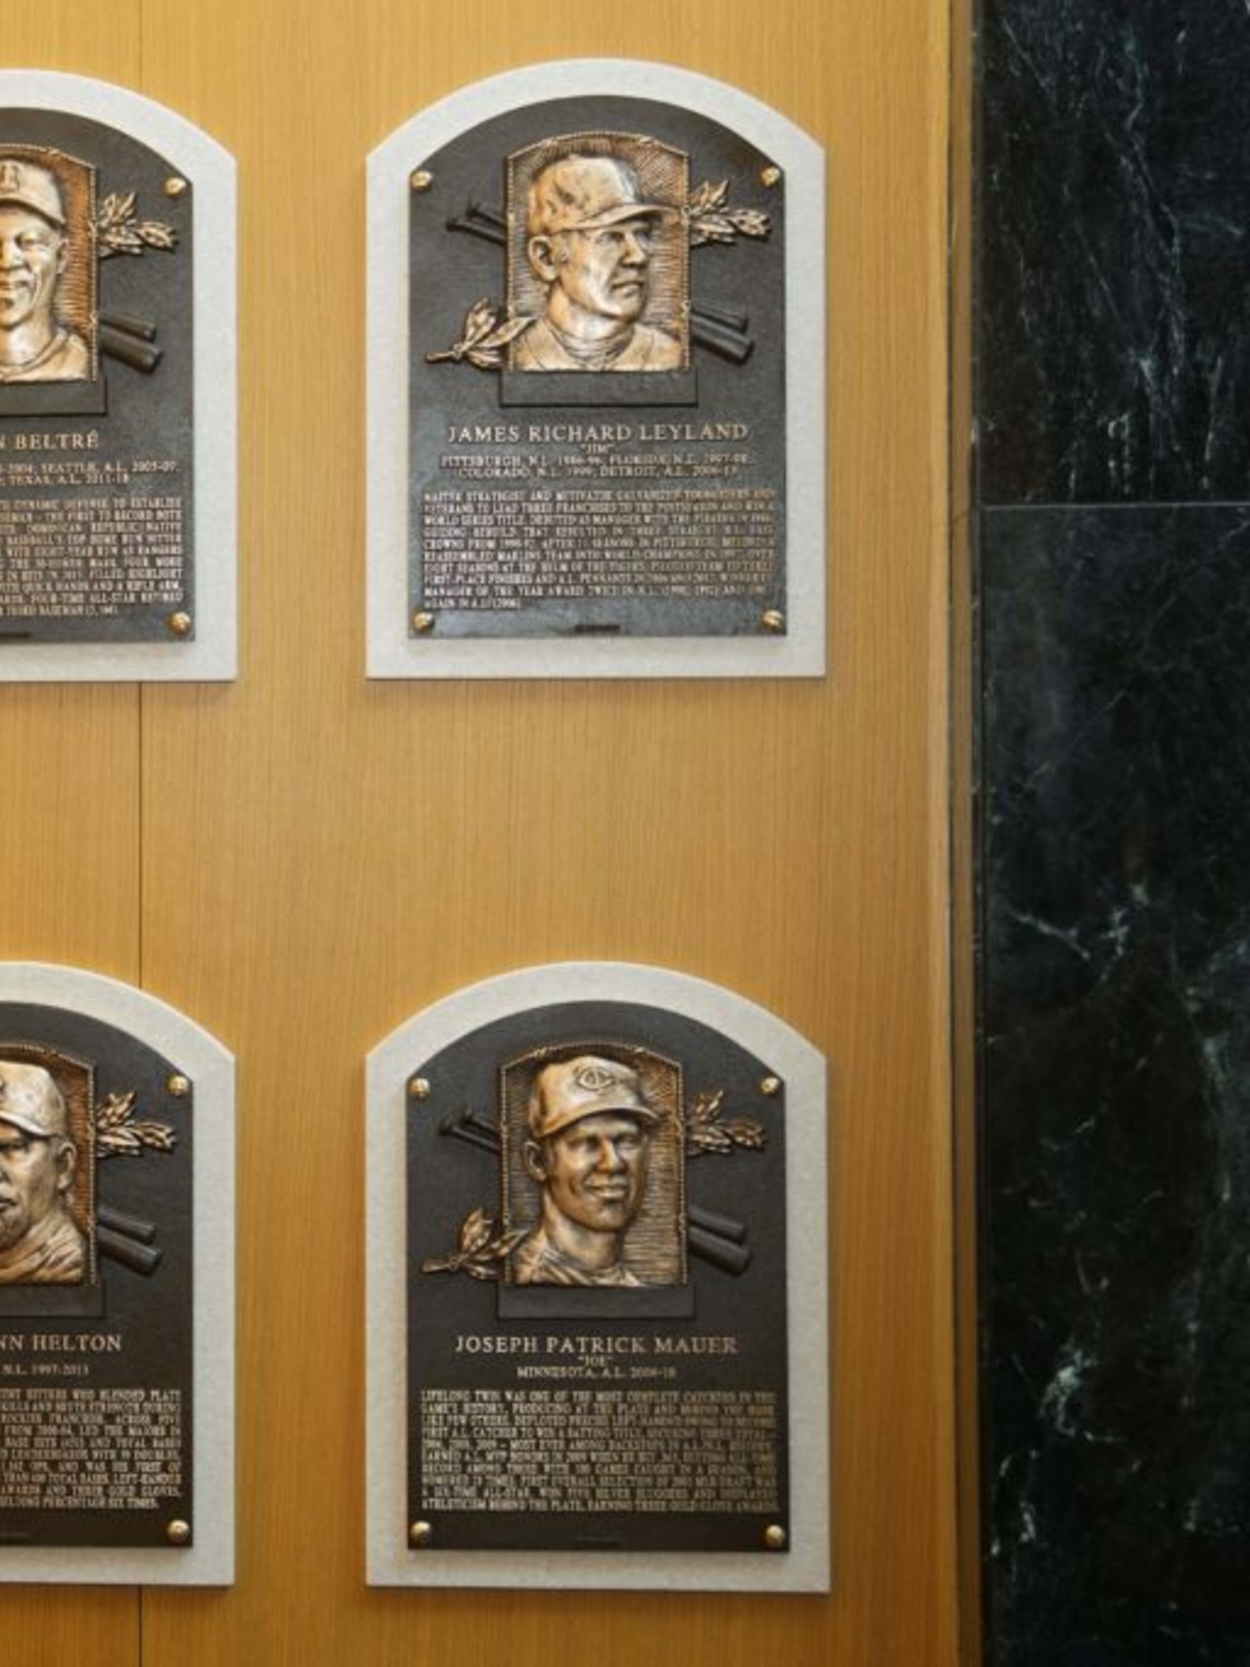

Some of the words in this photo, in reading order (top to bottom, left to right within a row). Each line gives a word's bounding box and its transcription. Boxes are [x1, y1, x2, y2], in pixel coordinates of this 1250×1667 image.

[15, 429, 99, 450] BELTRÉ
[448, 426, 519, 443] JAMES
[529, 424, 631, 442] RICHARD
[640, 423, 748, 441] LEYLAND
[33, 1333, 122, 1351] HELTON
[455, 1336, 538, 1353] JOSEPH
[546, 1336, 646, 1353] PATRICK
[654, 1336, 739, 1354] MAUER
[517, 1366, 600, 1379] MINNESOTA,
